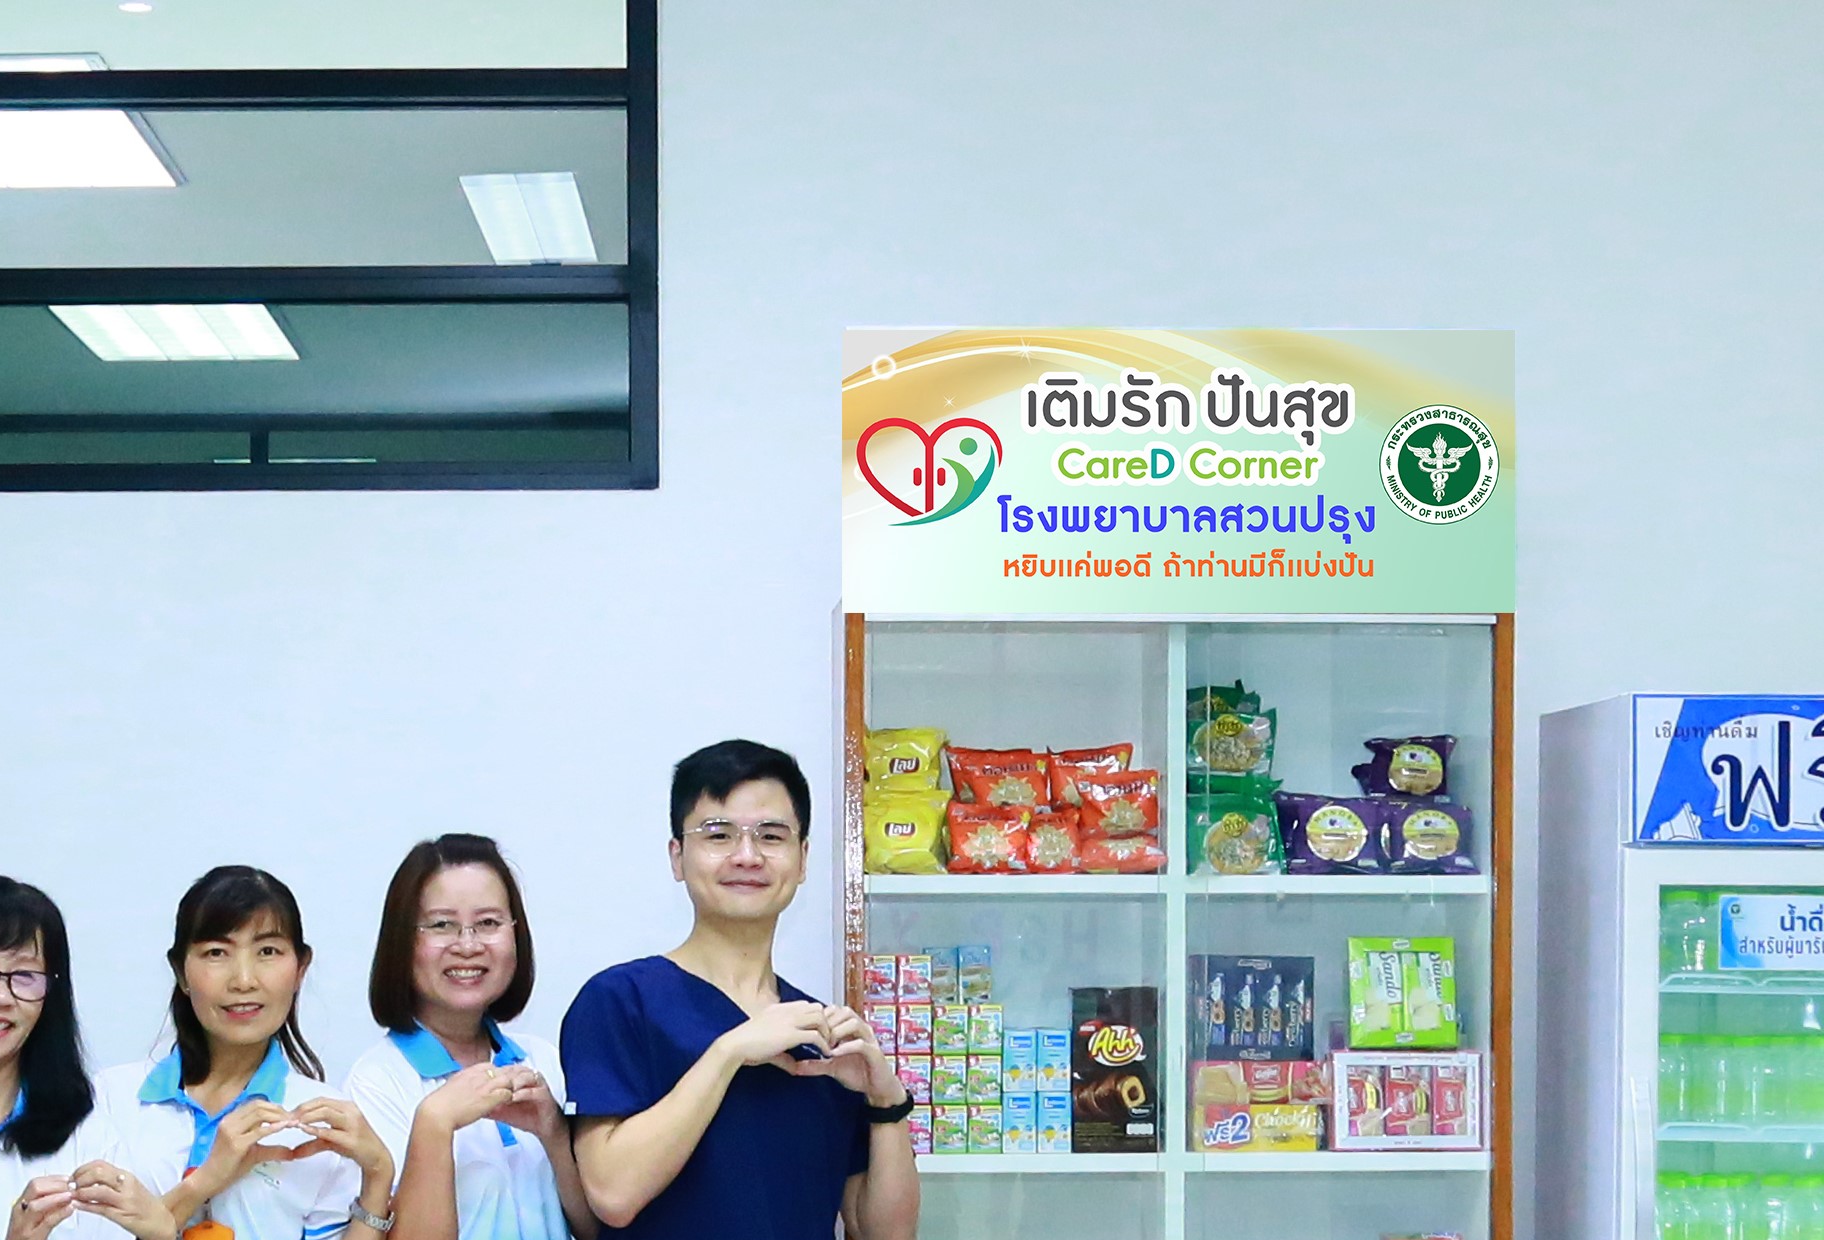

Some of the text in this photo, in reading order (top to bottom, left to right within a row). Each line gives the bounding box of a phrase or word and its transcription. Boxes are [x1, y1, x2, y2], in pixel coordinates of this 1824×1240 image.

[1026, 374, 1349, 445] เติมรัก ปันสุข
[1387, 408, 1493, 450] กระทรวงสาธารณสุข
[1058, 448, 1319, 481] CareD Corner
[1386, 474, 1493, 520] MINISTRY OF PUBLIC HEALTH
[998, 494, 1376, 545] โรงพยาบาลสวนปรุง
[1002, 548, 1375, 579] หยิบแค่พอดี ถ้าท่านมีก็แบ่งปัน
[1231, 1113, 1250, 1144] 2
